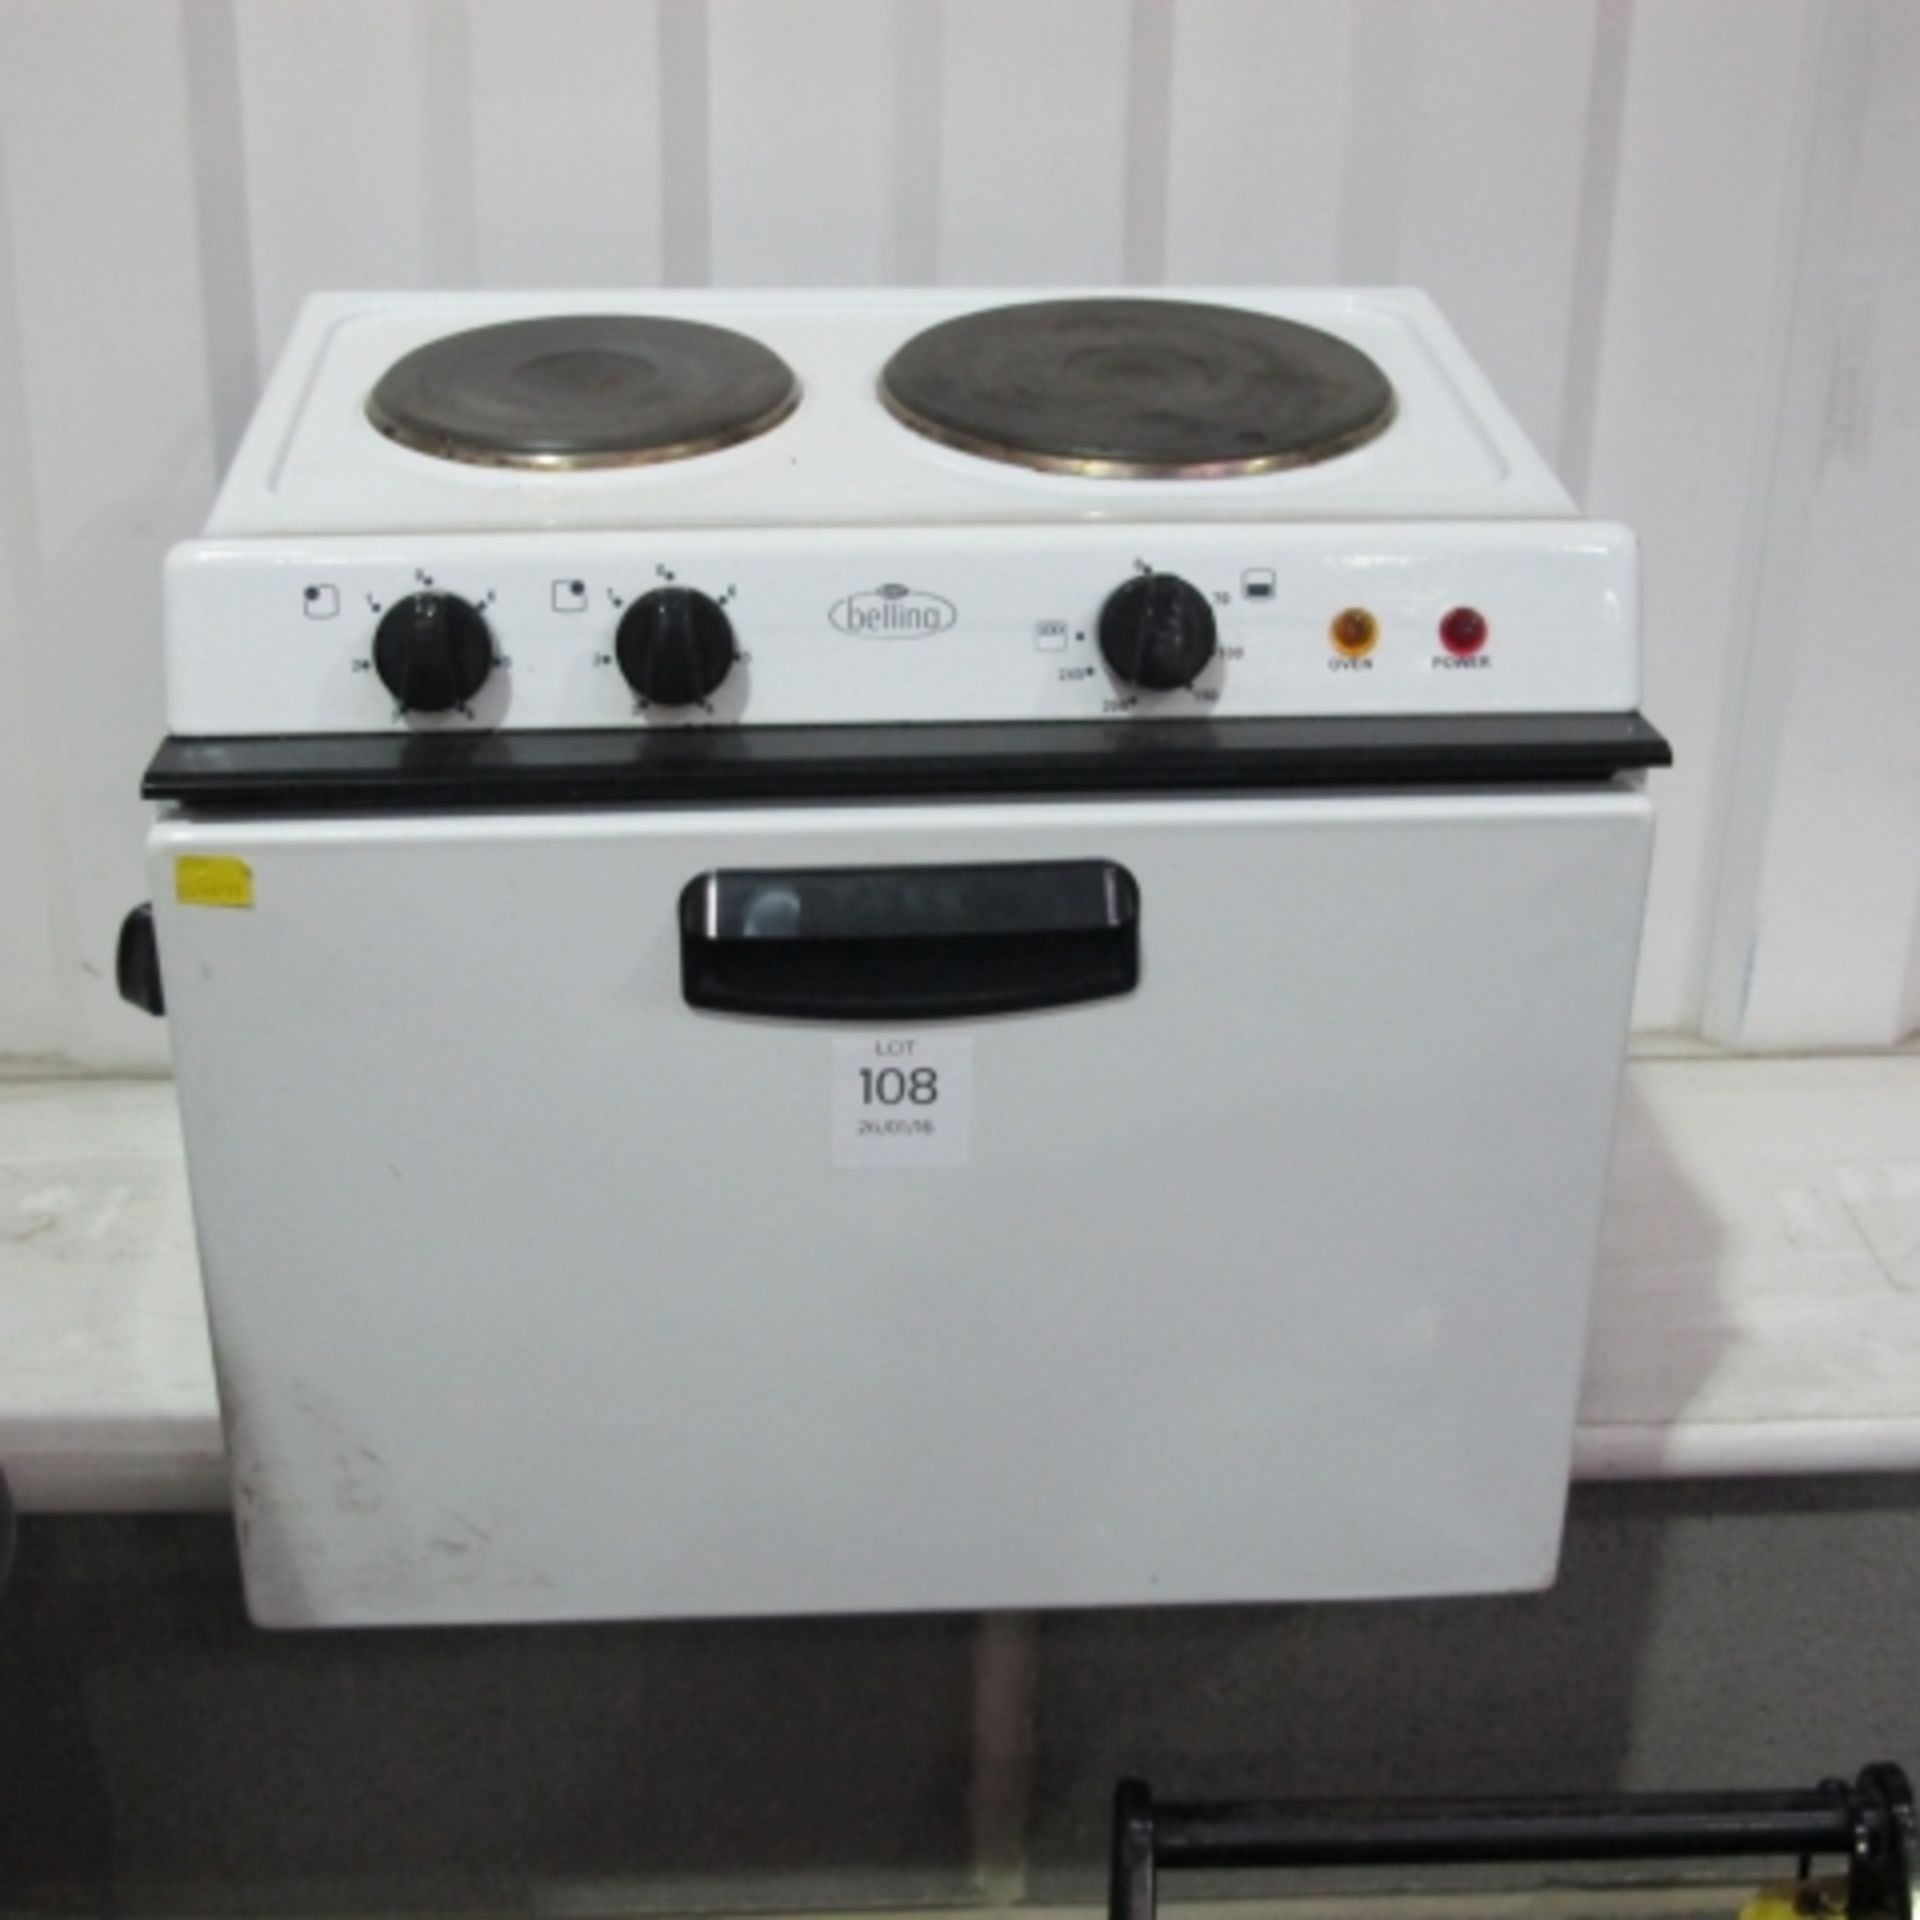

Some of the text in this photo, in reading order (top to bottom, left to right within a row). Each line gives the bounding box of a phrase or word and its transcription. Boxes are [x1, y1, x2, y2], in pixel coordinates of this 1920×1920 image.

[847, 595, 941, 635] belling
[1327, 658, 1374, 671] OVEN
[1431, 655, 1491, 669] POWER
[875, 1039, 916, 1056] LOT
[859, 1066, 938, 1105] 108
